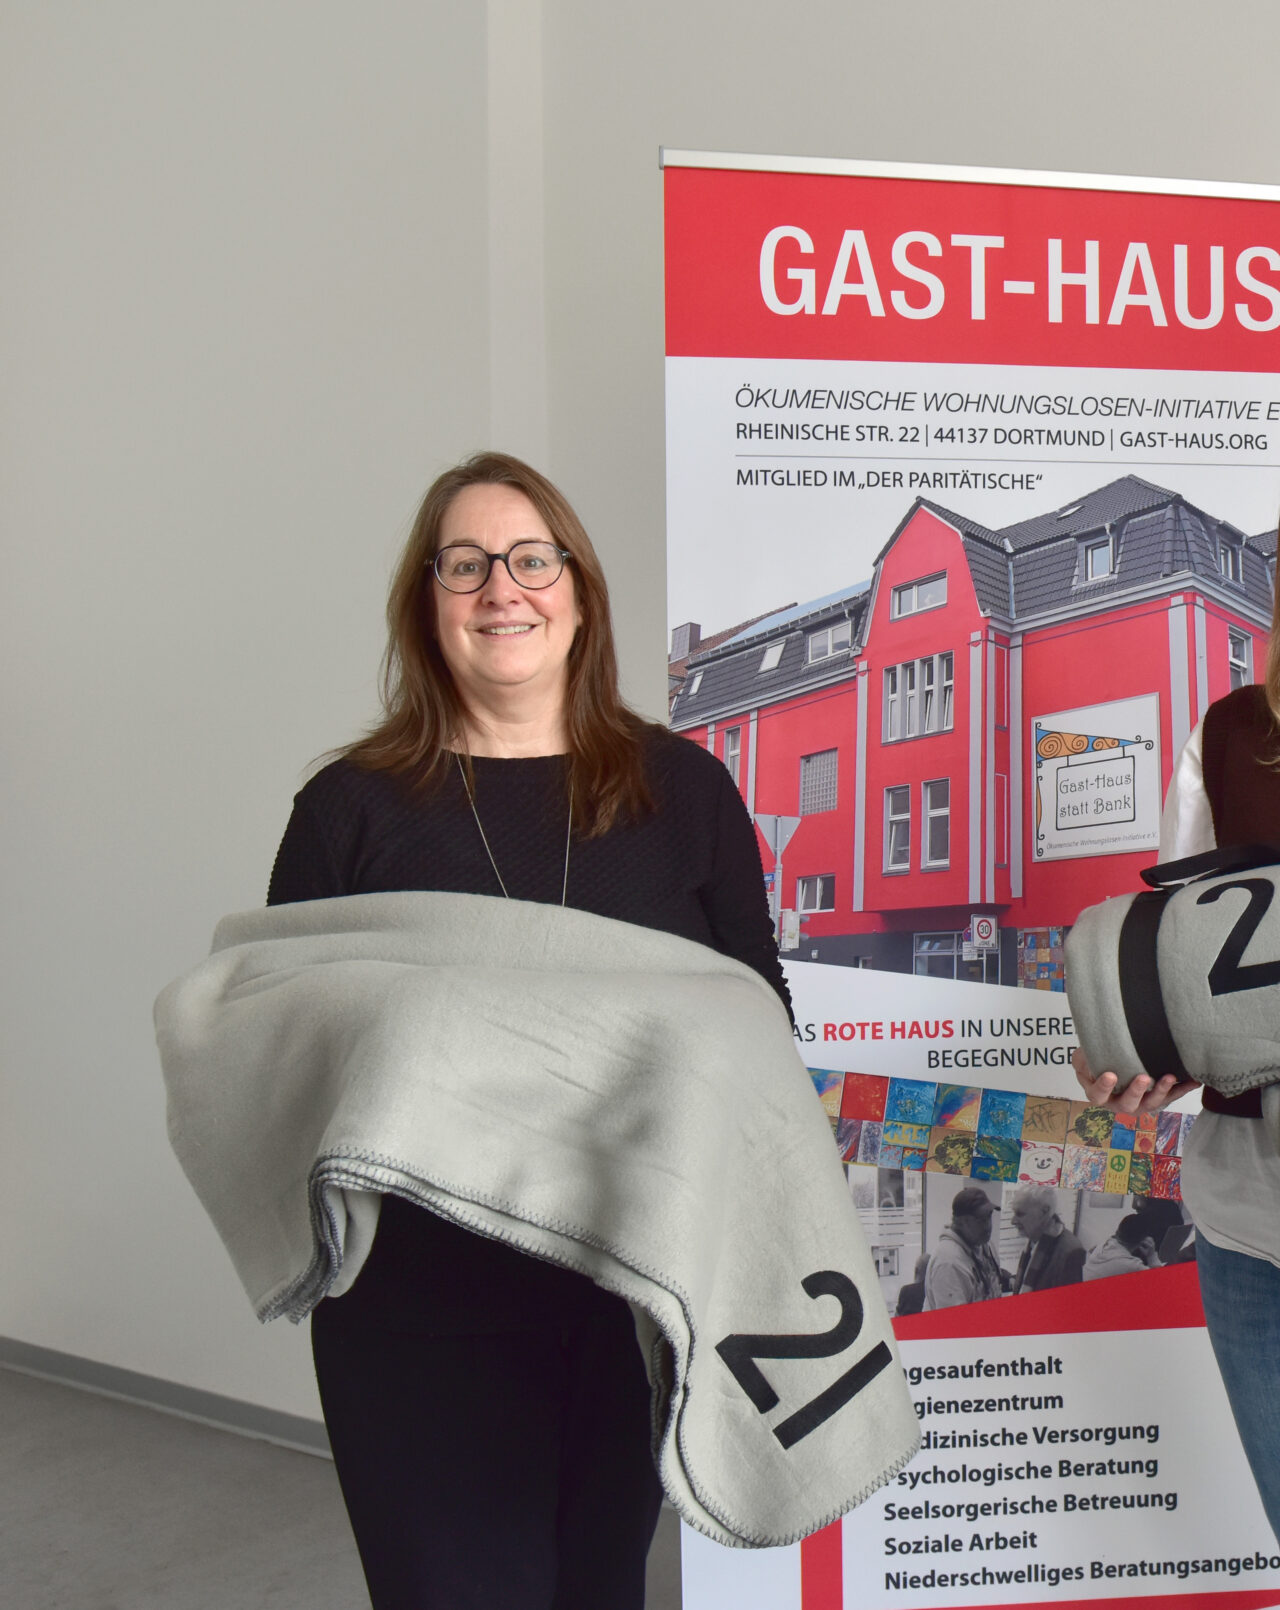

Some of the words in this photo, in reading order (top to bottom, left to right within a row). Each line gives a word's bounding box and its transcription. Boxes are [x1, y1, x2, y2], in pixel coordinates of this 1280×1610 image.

[735, 383, 918, 412] ÖKUMENISCHE
[923, 391, 1262, 420] WOHNUNGSLOSEN-INITIATIVE
[736, 422, 851, 442] RHEINISCHE
[855, 424, 894, 443] STR.
[898, 425, 920, 443] 22
[933, 427, 989, 445] 44137
[994, 428, 1106, 447] DORTMUND
[1119, 430, 1268, 451] GAST-HAUS.ORG
[736, 468, 828, 487] MITGLIED
[908, 470, 1043, 491] PARITÄTISCHE“
[1059, 774, 1132, 794] Gast-Haus
[1060, 802, 1088, 818] statt
[1093, 795, 1132, 815] Bank
[980, 925, 990, 935] 30
[793, 1023, 817, 1042] AS
[823, 1022, 884, 1042] ROTE
[890, 1019, 955, 1040] HAUS
[961, 1018, 983, 1038] IN
[989, 1016, 1074, 1038] UNSERE
[927, 1046, 1077, 1069] BEGEGNUNGE
[714, 1270, 894, 1450] 21
[903, 1355, 1063, 1385] gesaufenthalt
[913, 1394, 1064, 1420] gienezentrum
[920, 1427, 1029, 1450] dizinische
[1032, 1423, 1160, 1446] Versorgung
[898, 1460, 1053, 1490] sychologische
[1058, 1458, 1159, 1478] Beratung
[883, 1495, 1058, 1523] Seelsorgerische
[1063, 1491, 1179, 1511] Betreuung
[884, 1533, 964, 1556] Soziale
[968, 1531, 1038, 1552] Arbeit
[884, 1562, 1085, 1591] Niederschwelliges
